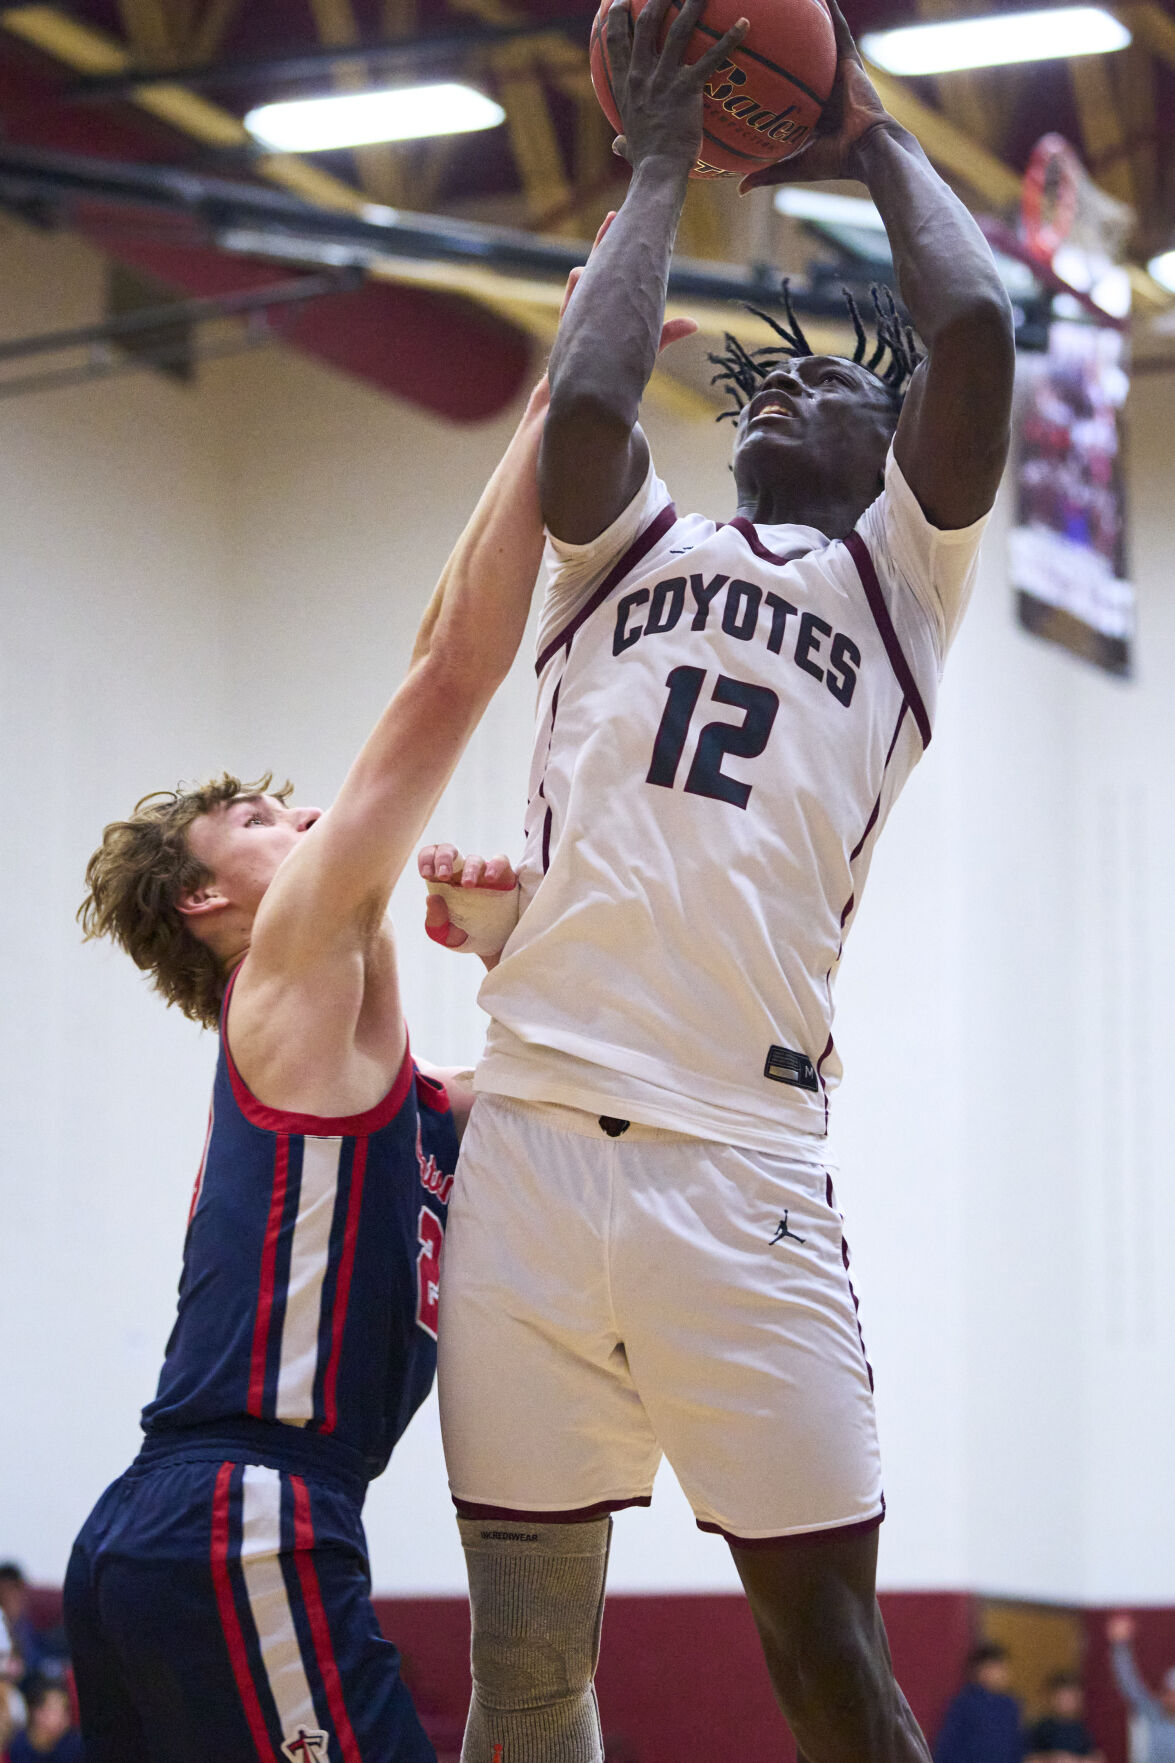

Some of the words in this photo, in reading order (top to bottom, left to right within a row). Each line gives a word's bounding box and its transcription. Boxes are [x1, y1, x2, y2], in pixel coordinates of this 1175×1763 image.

[703, 57, 810, 144] Baden
[612, 573, 862, 708] COYOTES
[645, 665, 780, 811] 12
